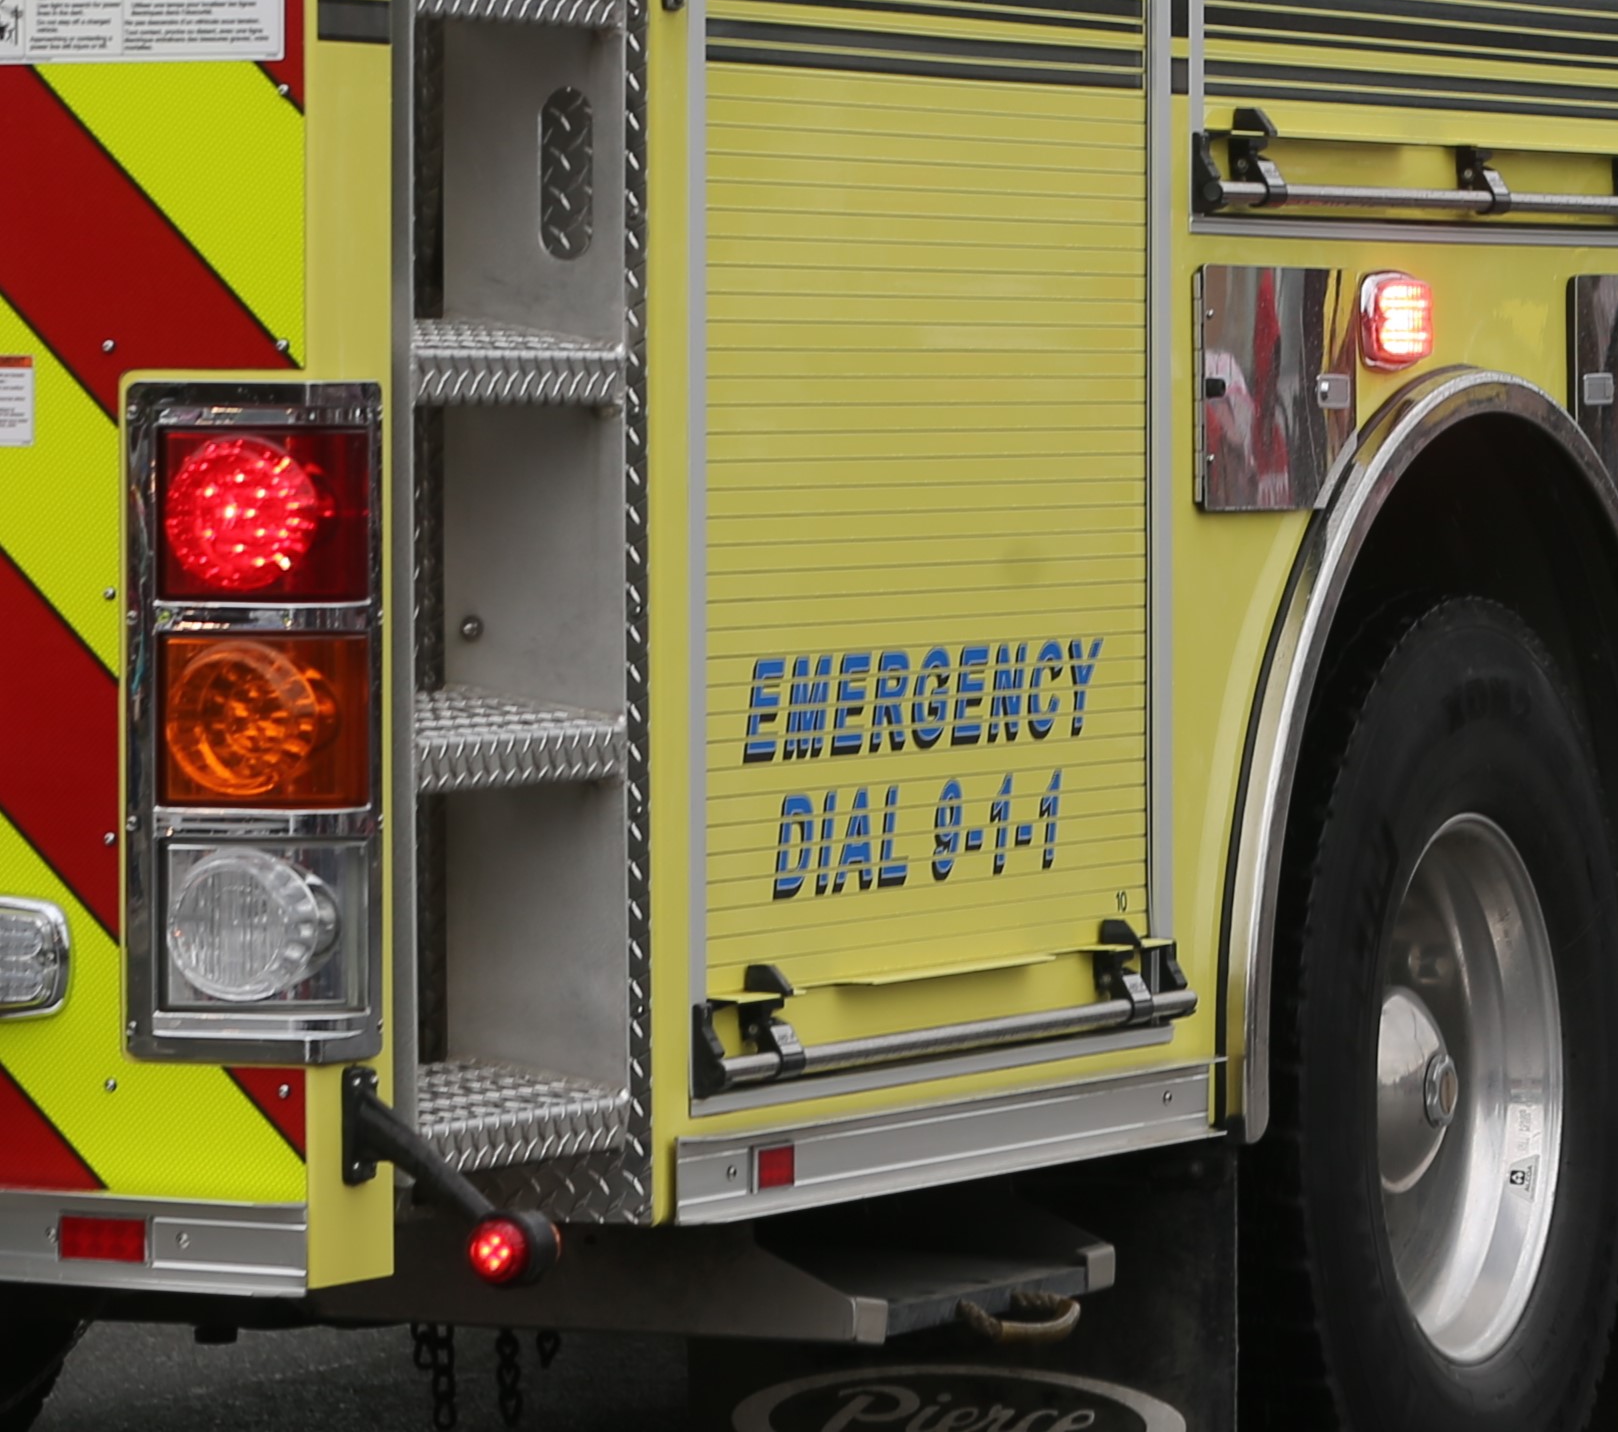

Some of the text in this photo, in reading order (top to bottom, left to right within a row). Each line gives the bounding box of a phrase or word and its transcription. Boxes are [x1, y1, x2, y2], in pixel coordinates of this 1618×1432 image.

[742, 636, 1104, 765] EMERGENCY
[772, 768, 1062, 901] DIAL 9-1-1
[1115, 890, 1128, 913] 10
[820, 1384, 1096, 1432] Pierce
